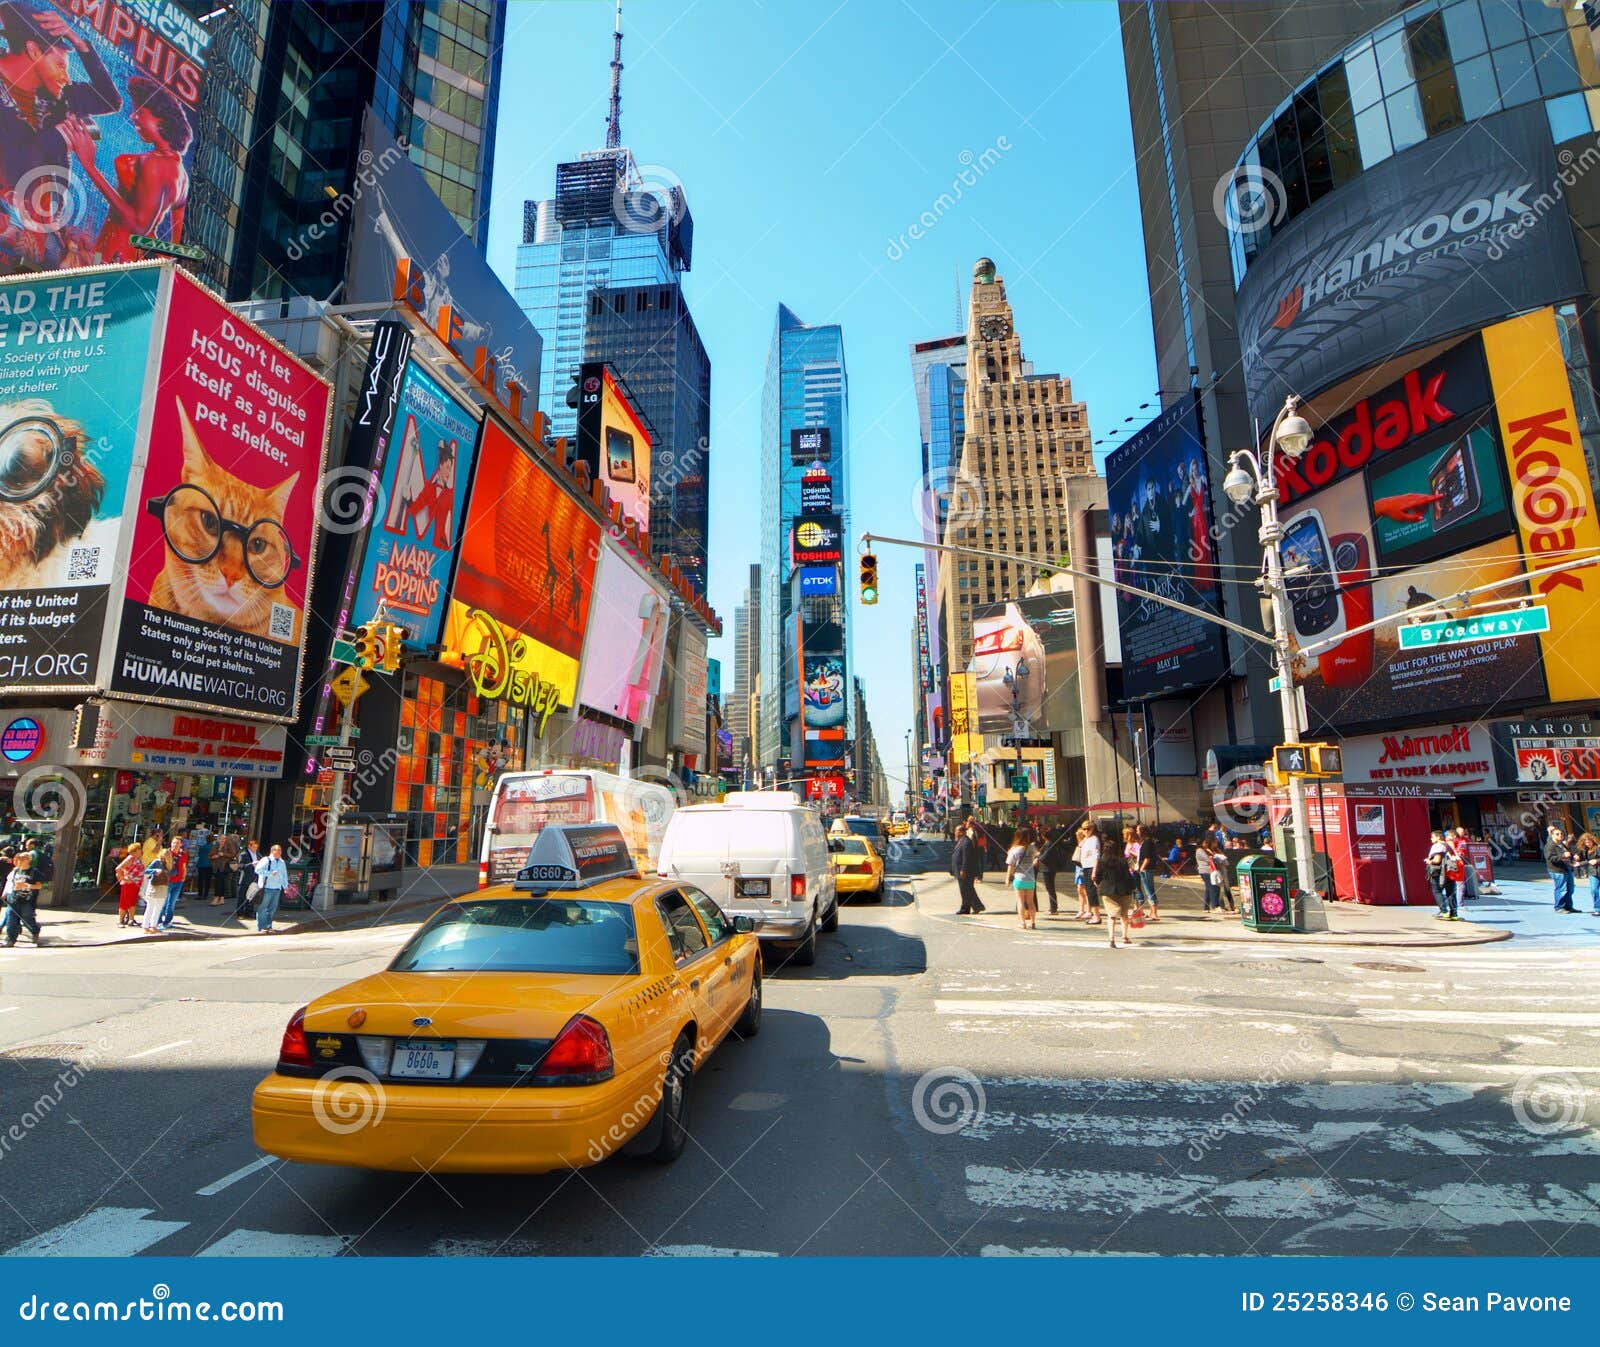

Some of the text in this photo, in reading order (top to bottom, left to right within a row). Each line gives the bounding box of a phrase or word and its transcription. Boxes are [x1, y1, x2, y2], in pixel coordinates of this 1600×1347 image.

[165, 4, 209, 47] AWARD
[136, 236, 199, 259] LAMAR
[46, 282, 106, 312] THE
[1334, 262, 1409, 306] driving
[18, 313, 112, 346] PRINT
[5, 344, 106, 364] Society of the U.S.
[221, 320, 291, 384] Don't let
[18, 380, 58, 393] shelter.
[37, 364, 60, 376] with
[63, 364, 90, 378] your
[191, 328, 307, 422] HSUS disguise
[184, 356, 305, 448] itself as a local
[584, 394, 598, 402] LG
[195, 401, 289, 467] pet shelter.
[1273, 368, 1456, 505] Kodak
[1507, 408, 1598, 594] Kodak
[389, 539, 436, 578] MARY
[795, 551, 840, 561] TOSHIBA
[373, 561, 440, 606] POPPINS
[810, 577, 833, 585] TDK
[11, 595, 32, 608] the
[35, 592, 79, 607] United
[9, 613, 25, 626] its
[28, 611, 76, 628] budget
[143, 609, 282, 656] The Humane Society of the United
[1421, 617, 1523, 641] Broadway
[140, 625, 281, 668] States only gives 1% of its budget
[172, 649, 255, 675] to local pet shelters.
[1389, 637, 1518, 673] BUILT FOR THE WAY YOU PLAY.
[1156, 656, 1171, 671] MAY
[122, 659, 286, 706] HUMANEWATCH.ORG
[173, 714, 261, 745] DIGITAL
[80, 750, 106, 759] PHOTO
[1379, 727, 1471, 764] Marriott
[1369, 760, 1490, 779] NEW YORK MARQUIS
[532, 867, 561, 879] 8G60
